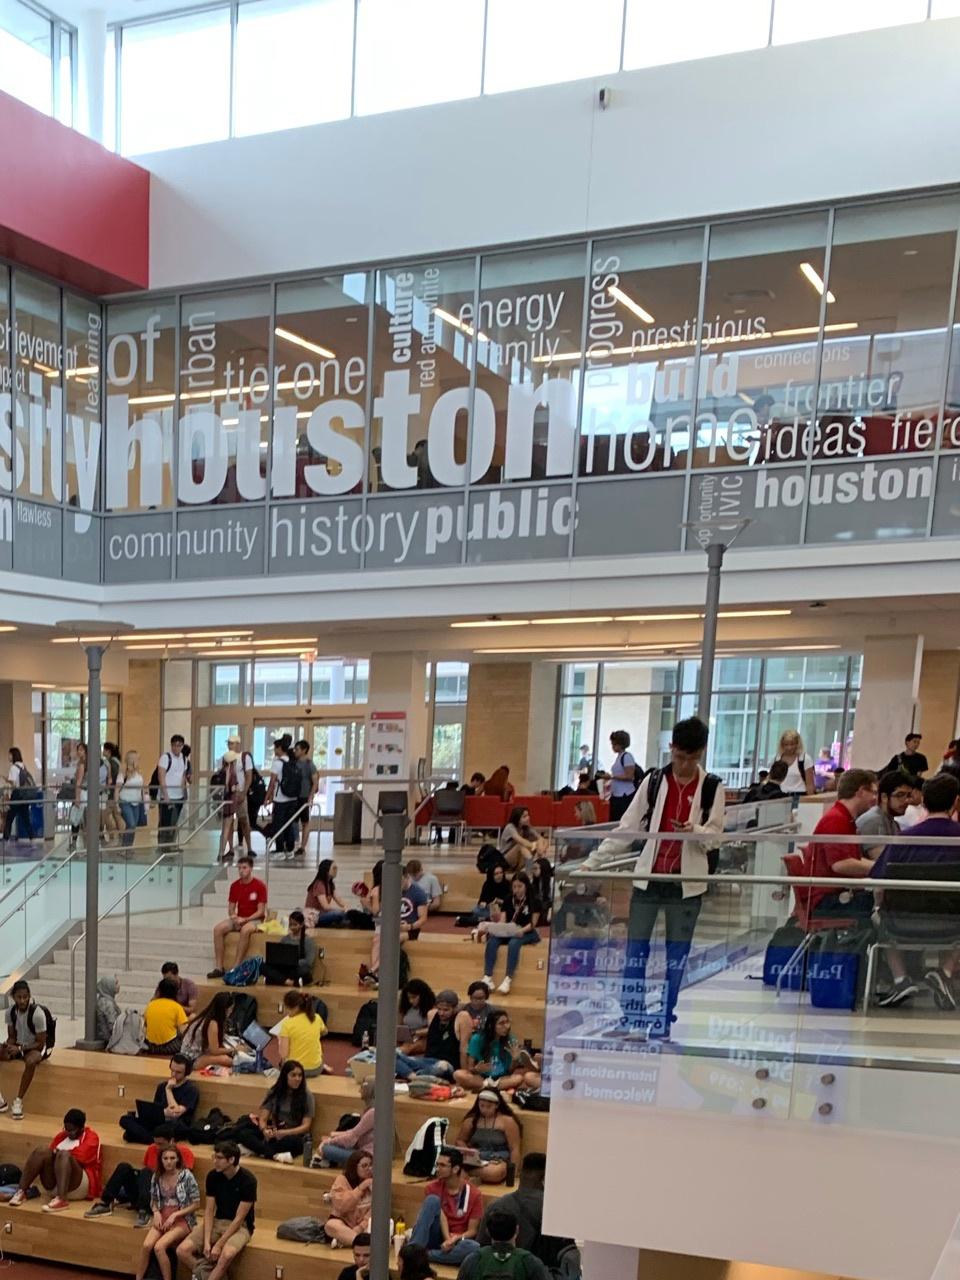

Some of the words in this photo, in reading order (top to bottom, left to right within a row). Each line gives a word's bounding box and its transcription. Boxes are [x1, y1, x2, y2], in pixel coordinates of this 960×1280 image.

[389, 271, 415, 364] culture
[459, 291, 565, 333] energy
[586, 255, 623, 389] progress
[631, 314, 767, 357] prestigious
[85, 312, 101, 414] leaning
[106, 313, 161, 388] of
[417, 359, 436, 388] red
[493, 332, 560, 367] amily
[754, 344, 851, 369] connectons
[224, 356, 287, 405] tier
[293, 356, 366, 400] one
[627, 352, 739, 405] build
[783, 372, 903, 414] frontier
[106, 369, 577, 510] houston
[585, 407, 760, 473] home
[765, 416, 867, 461] ideas
[698, 474, 717, 546] oportunity
[754, 462, 933, 509] houston
[17, 501, 52, 529] flawless
[271, 505, 420, 563] history
[425, 487, 580, 555] public
[109, 520, 258, 561] community
